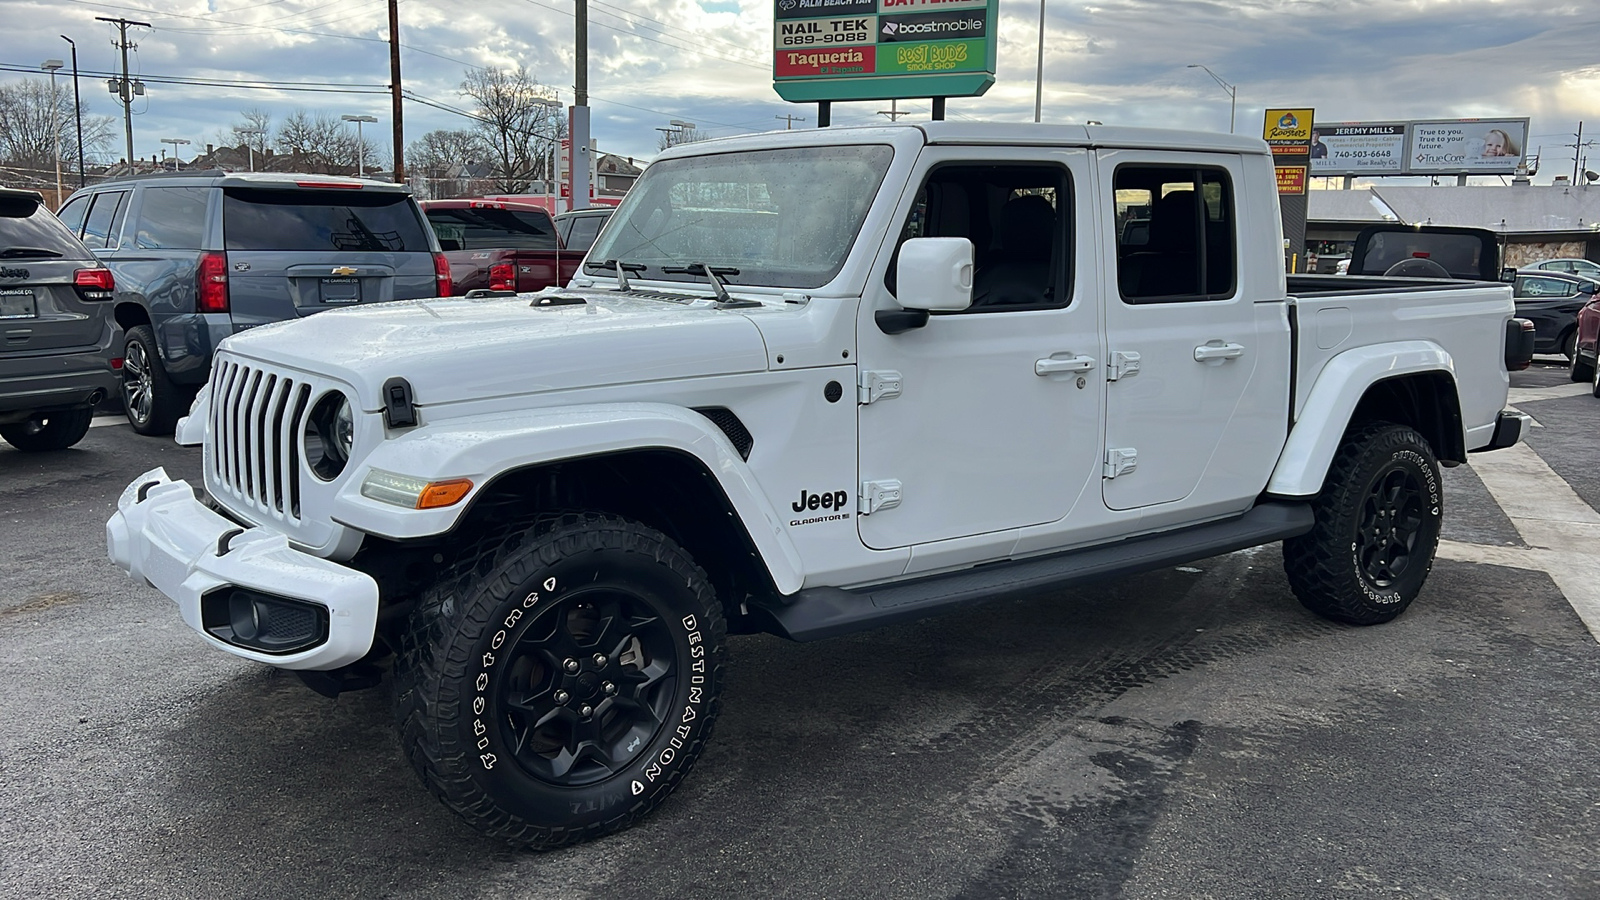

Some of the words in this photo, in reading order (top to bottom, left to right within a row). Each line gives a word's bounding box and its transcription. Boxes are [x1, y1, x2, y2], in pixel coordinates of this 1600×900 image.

[781, 22, 822, 36] NAIL
[829, 19, 868, 32] TEK
[899, 18, 983, 34] boostmobile
[783, 32, 867, 46] 689-9088
[906, 62, 933, 72] SMOKE
[934, 61, 956, 71] SHOP
[1269, 127, 1307, 139] Roosters
[1335, 127, 1368, 135] JEREMY
[1369, 126, 1395, 134] MILLS
[1446, 136, 1465, 144] your
[1334, 150, 1391, 159] 740-503-6648
[1369, 159, 1387, 168] Realty
[0, 266, 30, 280] Jeep
[1391, 449, 1439, 505] DESTINATION
[791, 489, 848, 513] Jeep
[789, 514, 842, 527] GLADIATOR
[472, 591, 539, 771] Firestone
[645, 613, 708, 783] DESTINATION
